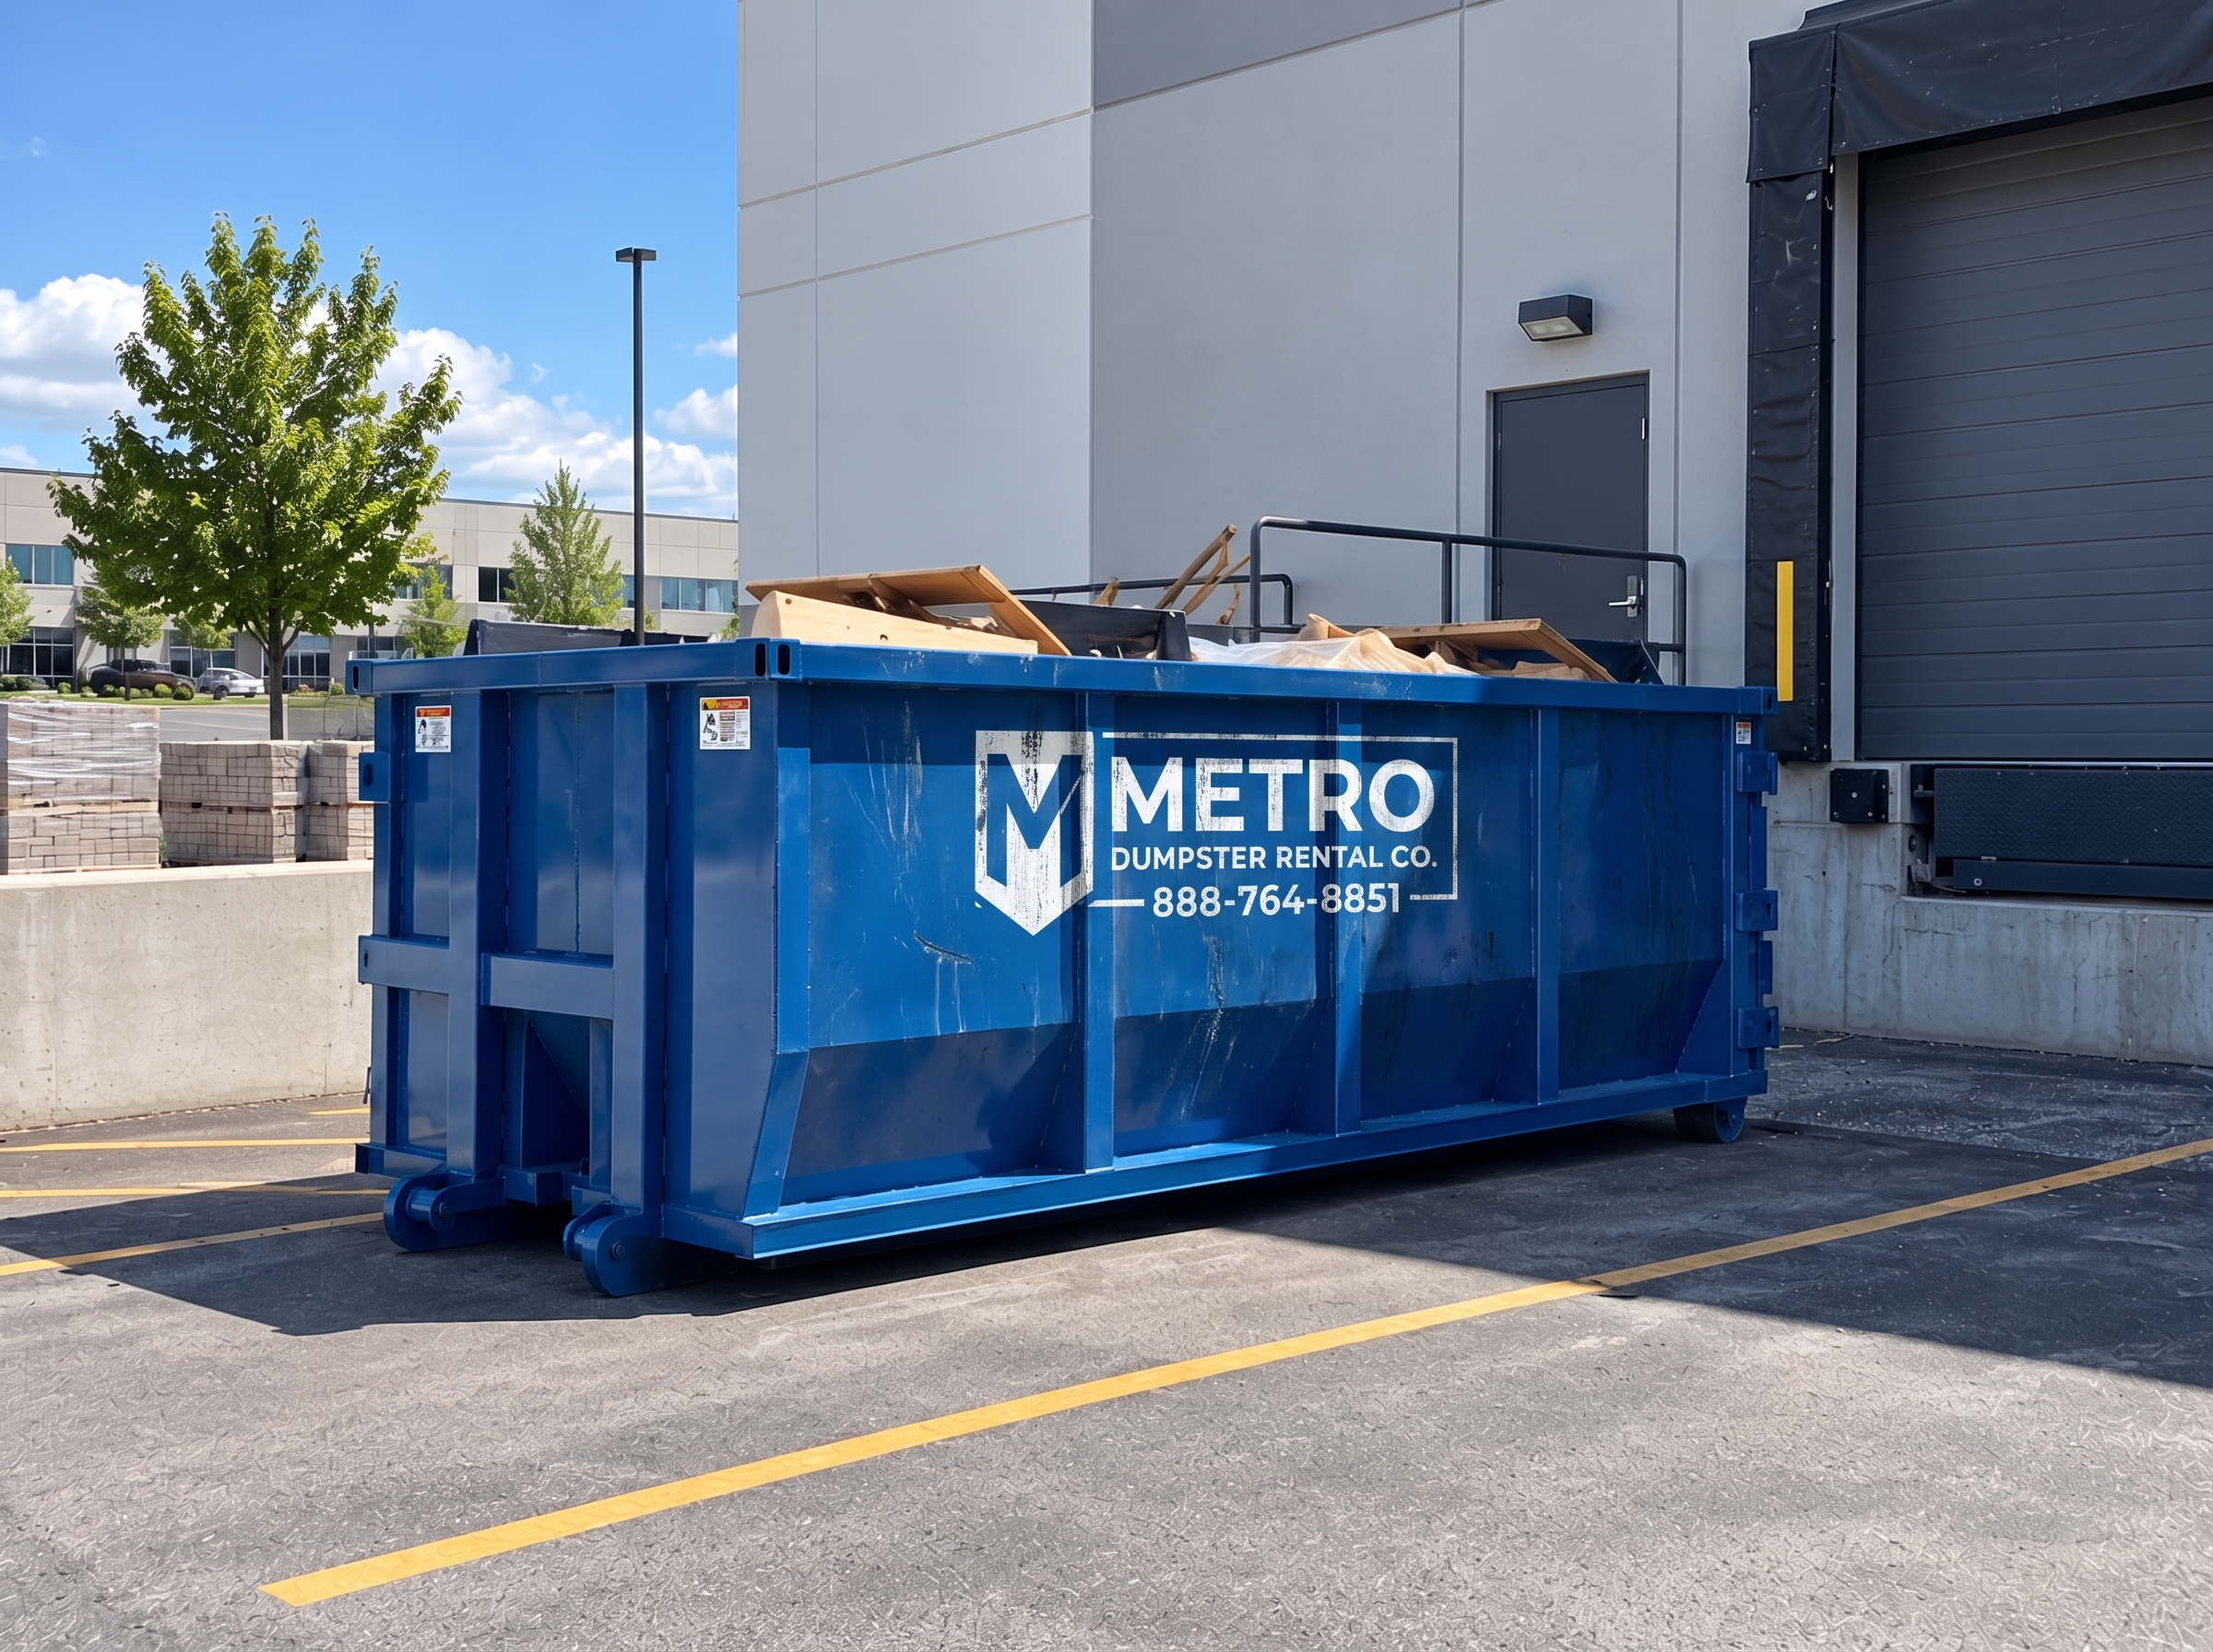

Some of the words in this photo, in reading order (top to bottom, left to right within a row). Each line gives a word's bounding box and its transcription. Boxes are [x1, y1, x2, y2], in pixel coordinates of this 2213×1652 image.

[1111, 756, 1435, 832] METRO
[1111, 845, 1267, 871] DUMPSTER
[1276, 844, 1383, 868] RENTAL
[1391, 844, 1438, 868] CO.
[1153, 882, 1400, 918] 888-764-8851
